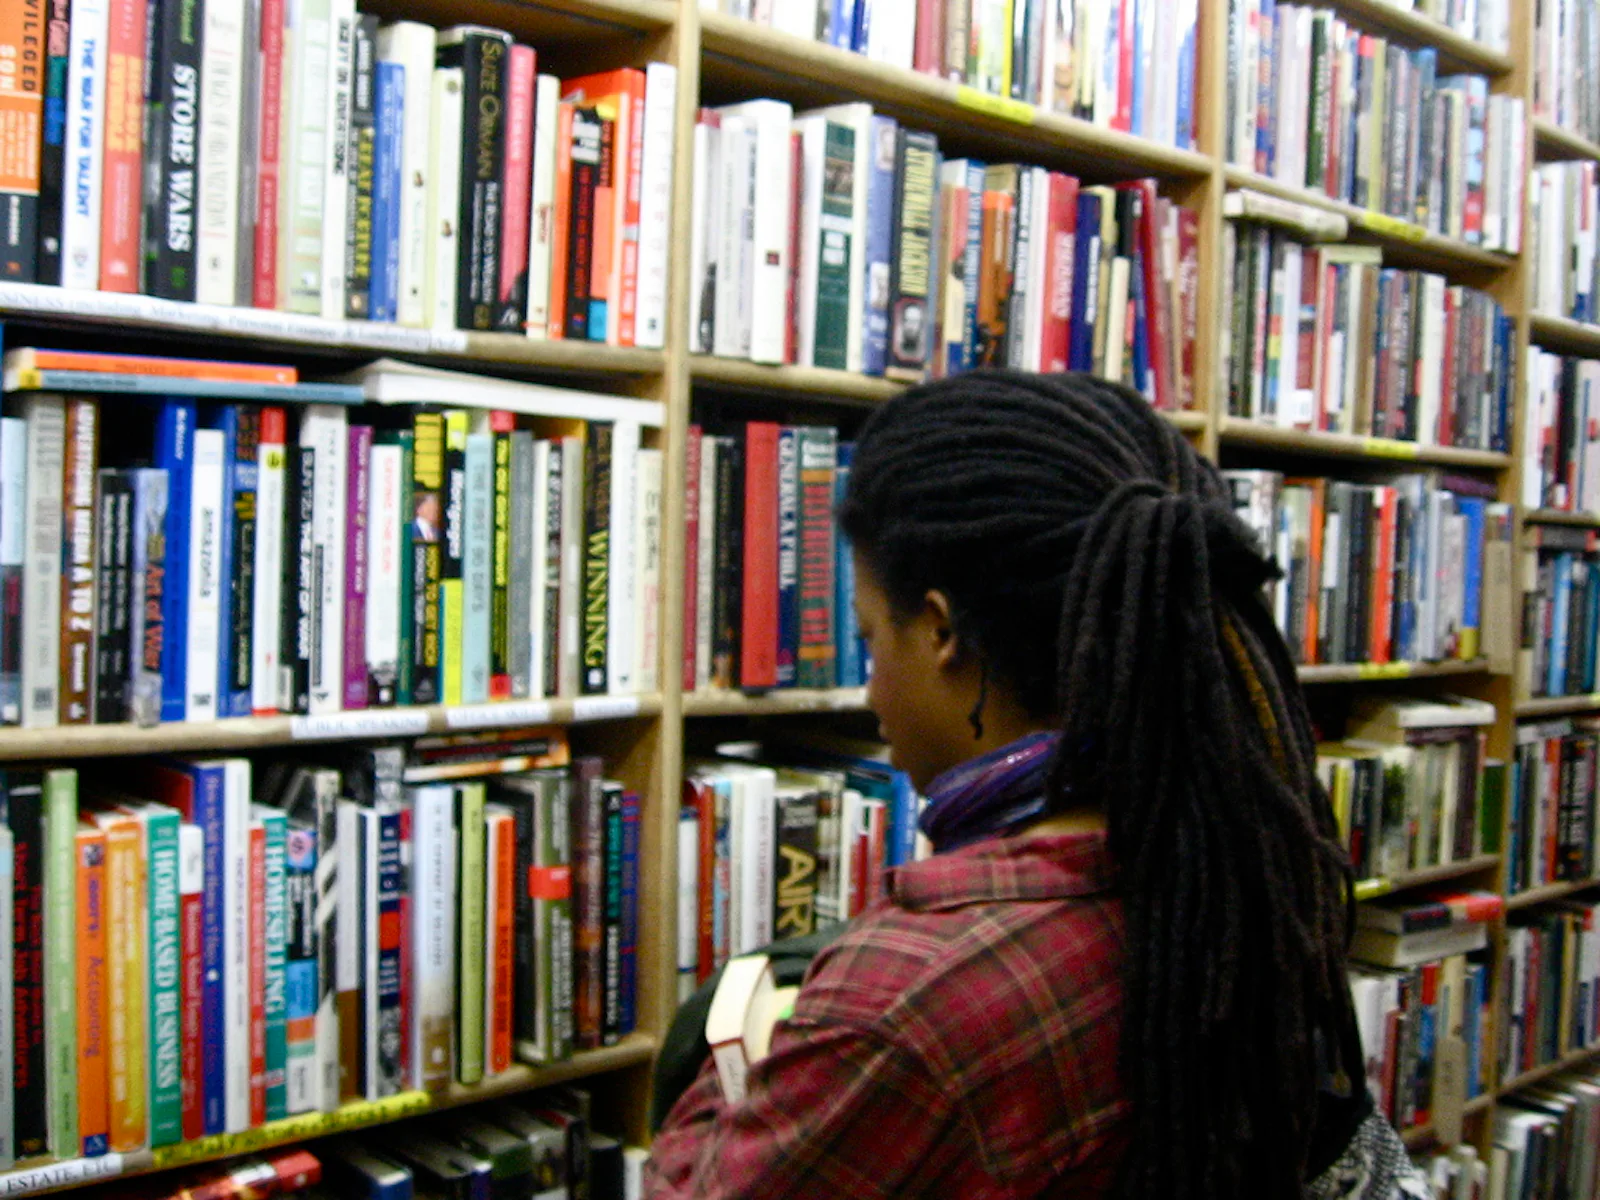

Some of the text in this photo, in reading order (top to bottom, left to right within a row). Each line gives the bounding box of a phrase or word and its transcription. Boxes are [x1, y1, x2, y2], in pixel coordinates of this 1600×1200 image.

[83, 40, 97, 69] THE
[80, 115, 94, 149] FOR
[167, 62, 198, 253] STORE WARS
[477, 41, 503, 179] SUZE ORMAN
[76, 155, 92, 217] TALENT
[899, 146, 935, 297] STONEWALL JACKSON
[199, 506, 215, 599] amazonia
[446, 469, 464, 559] Mortgages
[70, 586, 92, 614] TO
[71, 566, 93, 583] A
[143, 562, 166, 670] Art of War
[584, 528, 610, 668] WINNING
[70, 615, 92, 632] Z
[263, 845, 287, 1015] HOMESELLING
[776, 844, 817, 941] AIR
[84, 954, 105, 1058] Accounting
[154, 849, 179, 1089] HOME-BASED BUSINESS
